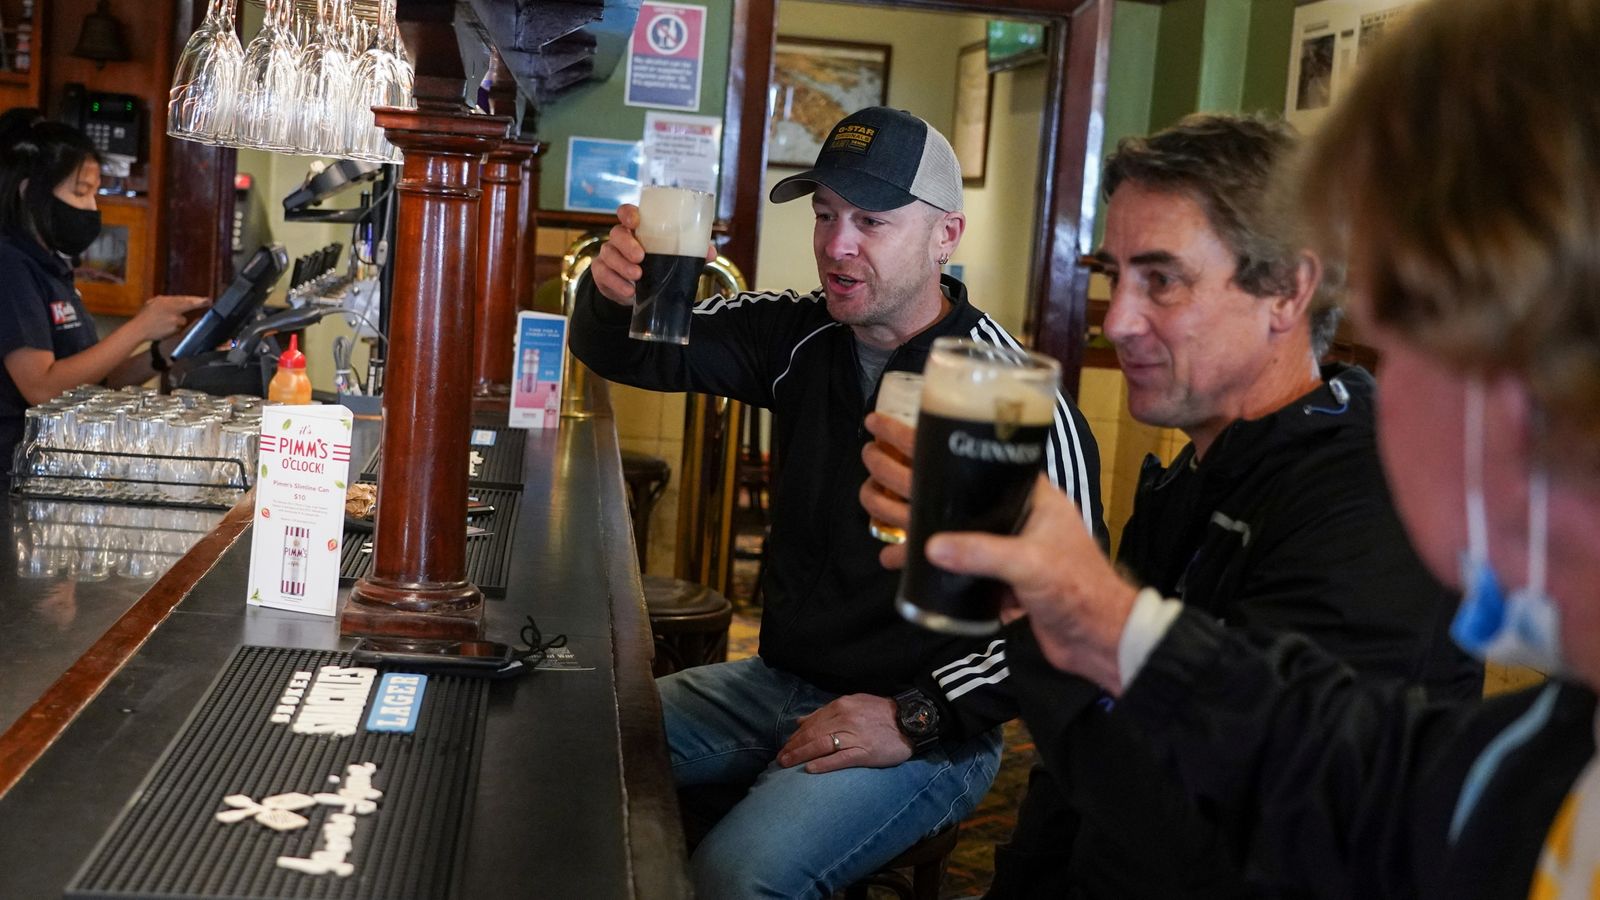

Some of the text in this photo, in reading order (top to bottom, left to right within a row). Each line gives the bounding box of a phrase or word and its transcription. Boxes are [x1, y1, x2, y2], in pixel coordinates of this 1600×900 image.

[838, 125, 875, 137] G-STAR
[279, 437, 328, 459] PIMM'S
[281, 457, 325, 475] O'CLOCK!
[293, 493, 306, 501] $10
[375, 675, 420, 728] LAGER
